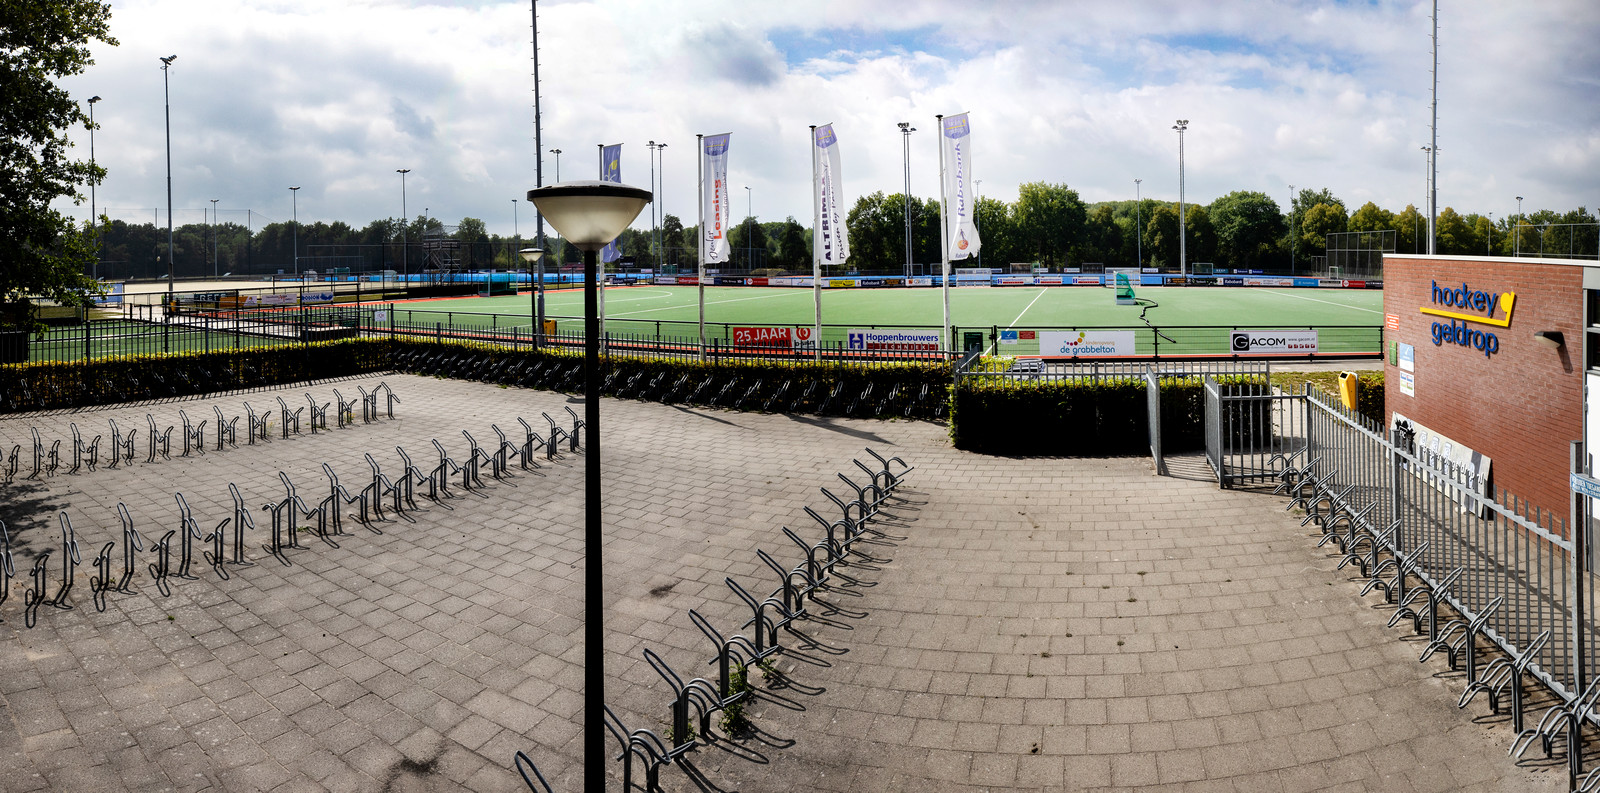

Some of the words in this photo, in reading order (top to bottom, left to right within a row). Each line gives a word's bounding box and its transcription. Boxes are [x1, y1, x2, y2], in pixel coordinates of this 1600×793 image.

[955, 142, 965, 217] Rabobank
[713, 179, 722, 239] Leasing
[706, 230, 718, 260] Dealer
[836, 227, 846, 260] Driven
[1431, 279, 1497, 317] hockey
[736, 330, 751, 342] 25
[754, 327, 787, 340] JAAR
[866, 333, 939, 342] Hoppenbrouwers
[1060, 345, 1070, 354] de
[1072, 345, 1116, 355] grabbelton
[1233, 335, 1287, 349] GACOM
[1431, 318, 1498, 357] geldrop
